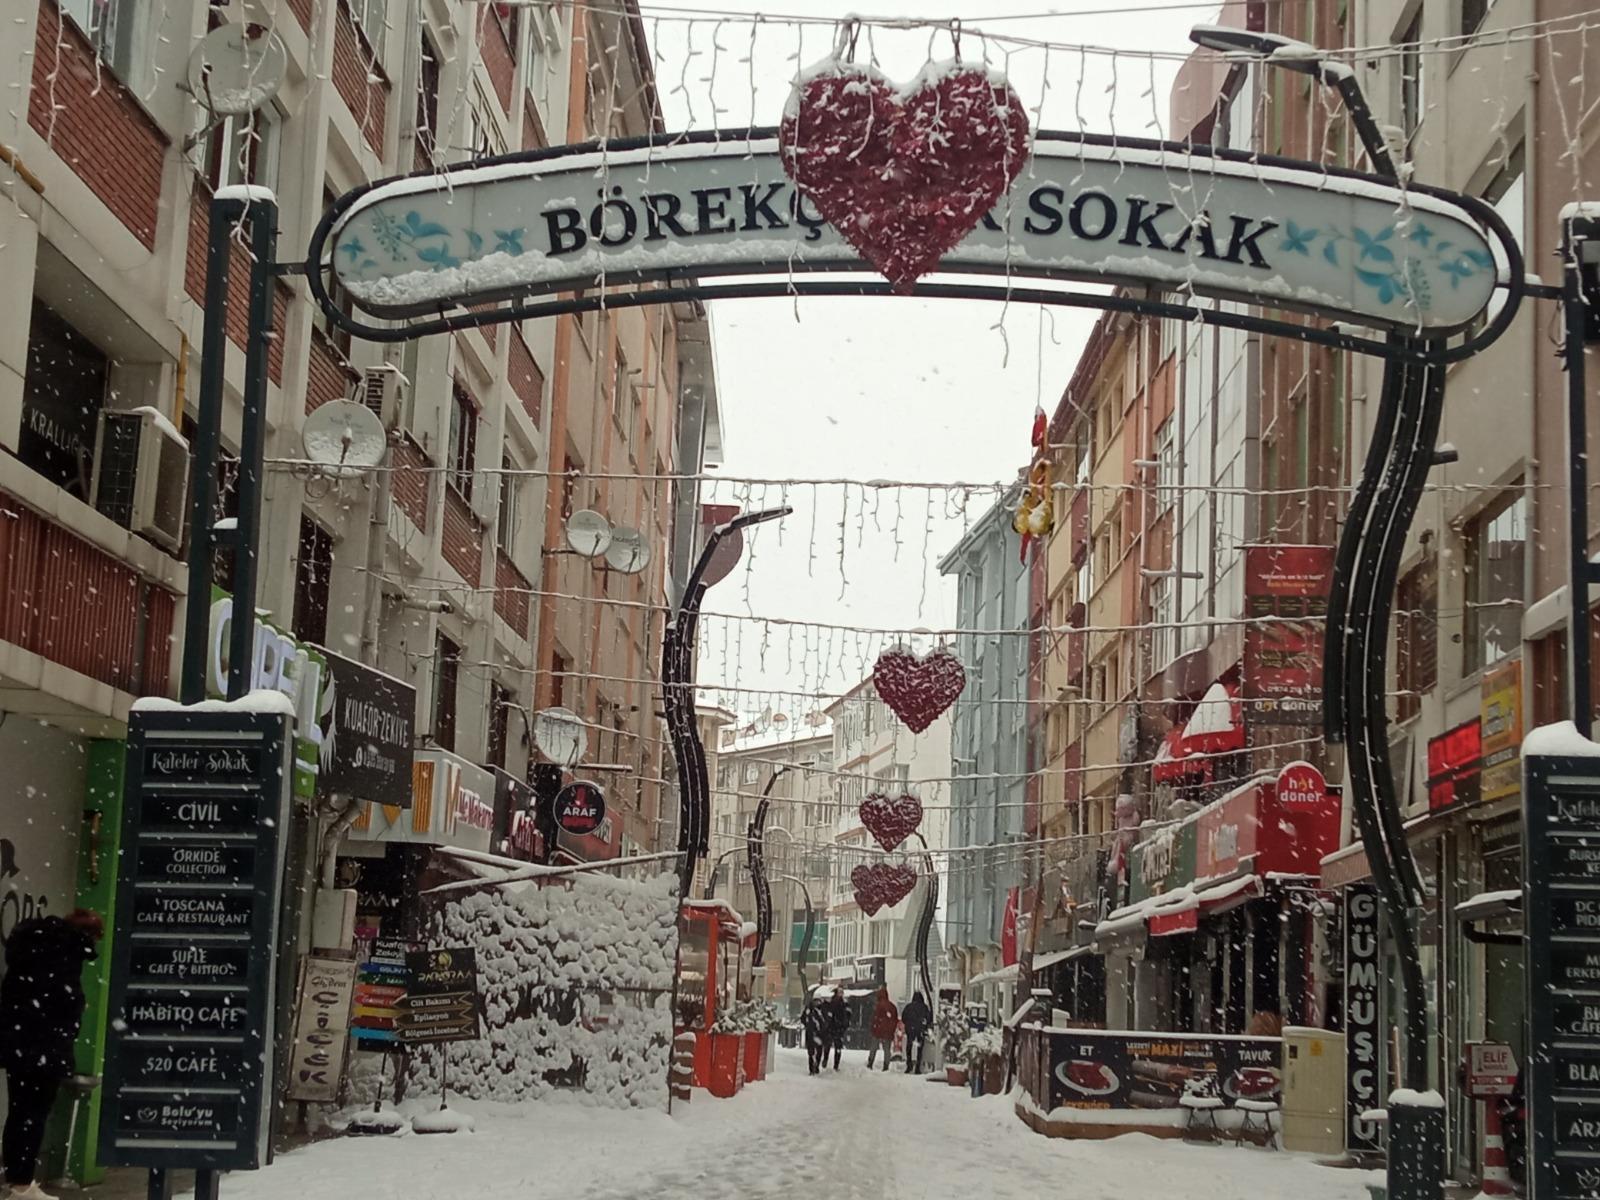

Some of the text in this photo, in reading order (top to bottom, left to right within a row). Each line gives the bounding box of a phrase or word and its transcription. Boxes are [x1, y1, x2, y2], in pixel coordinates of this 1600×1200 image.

[1023, 186, 1279, 270] SOKAK
[205, 751, 253, 774] Sokak
[1280, 790, 1322, 802] döner
[562, 806, 597, 817] ARAF
[166, 863, 226, 875] COLLECTION
[162, 899, 225, 912] TOSCANA
[137, 912, 248, 924] CAFE & RESTAURANT
[171, 949, 207, 963] SUFLE
[148, 963, 175, 975] CAFE
[410, 999, 424, 1007] Cilt
[198, 1007, 238, 1022] CAFE
[414, 1013, 449, 1023] Epilasyon
[1350, 894, 1376, 1141] GÜMÜŞÇÜ
[405, 1028, 434, 1038] Bölgesel
[1079, 1045, 1094, 1056] ET
[1238, 1050, 1272, 1061] TAVUK
[176, 1057, 217, 1072] CAFE
[1568, 1064, 1600, 1081] BLA
[162, 1105, 213, 1119] Bolu'yu
